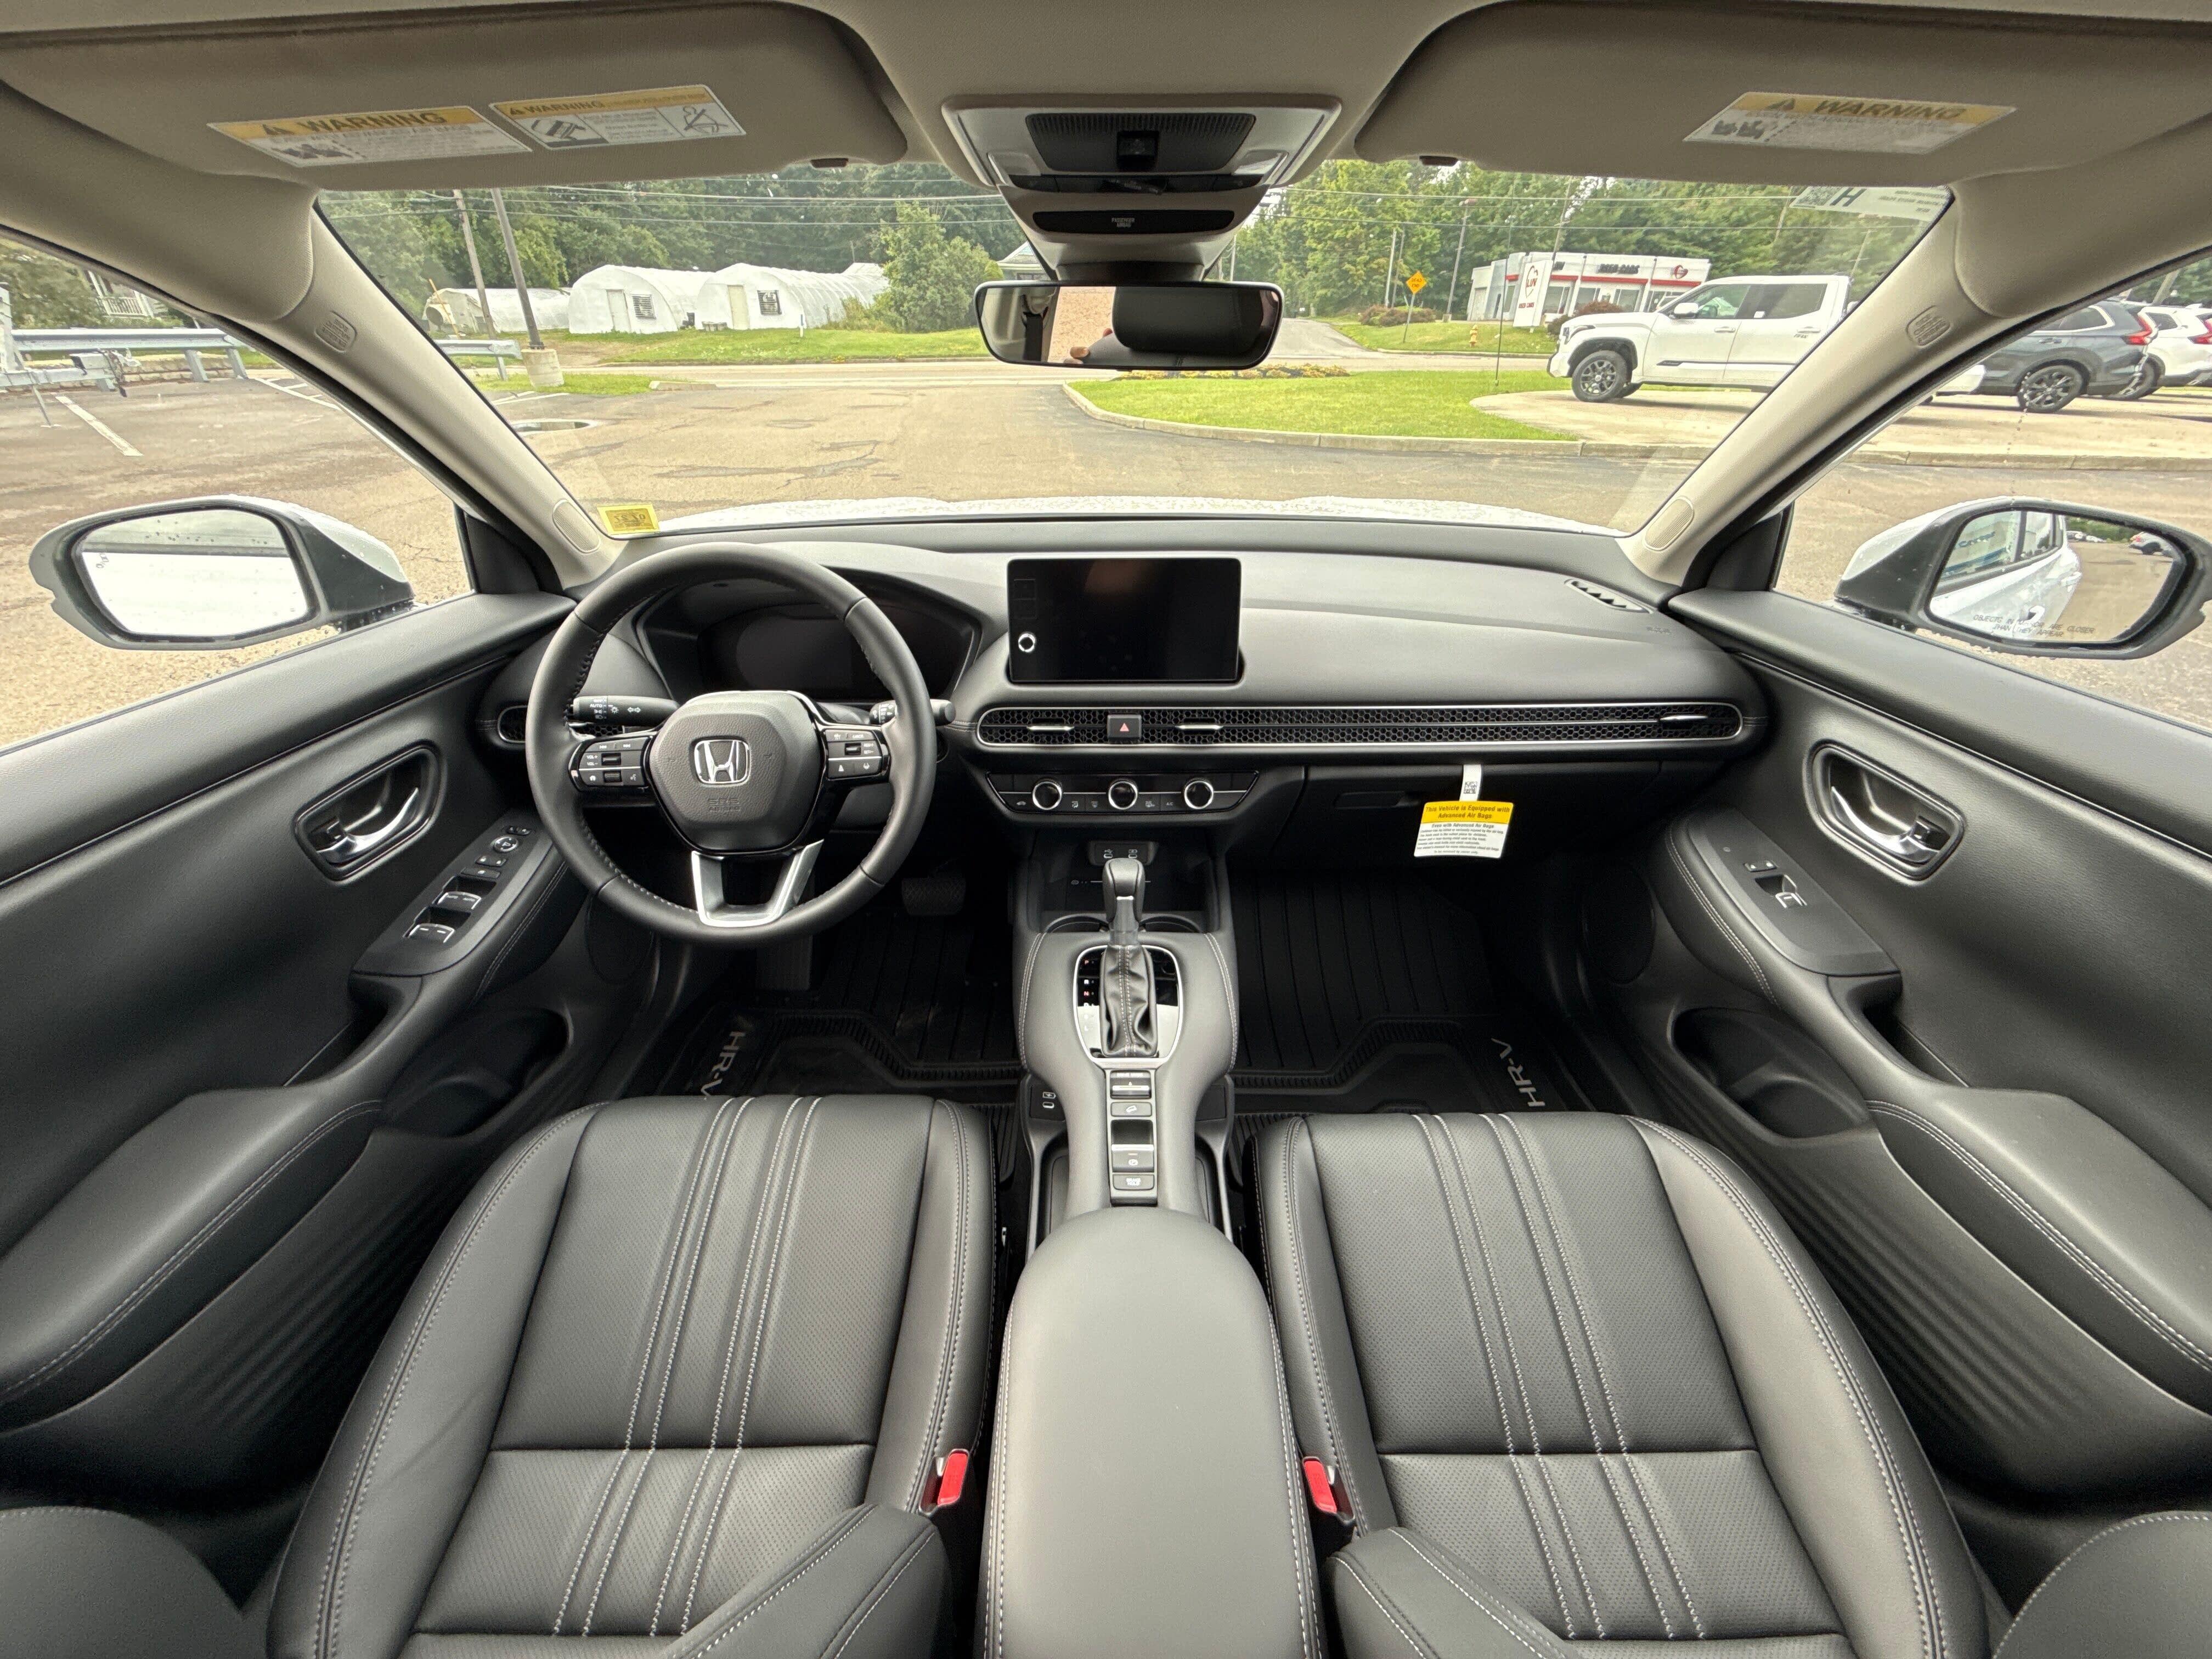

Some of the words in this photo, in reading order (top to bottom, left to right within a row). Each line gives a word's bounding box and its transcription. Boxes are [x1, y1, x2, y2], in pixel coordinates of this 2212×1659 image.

[522, 101, 605, 114] WARNING
[1814, 100, 1966, 120] WARNING
[297, 112, 447, 132] WARNING
[1526, 278, 1538, 287] LUV
[1973, 614, 2002, 623] OBJECTS
